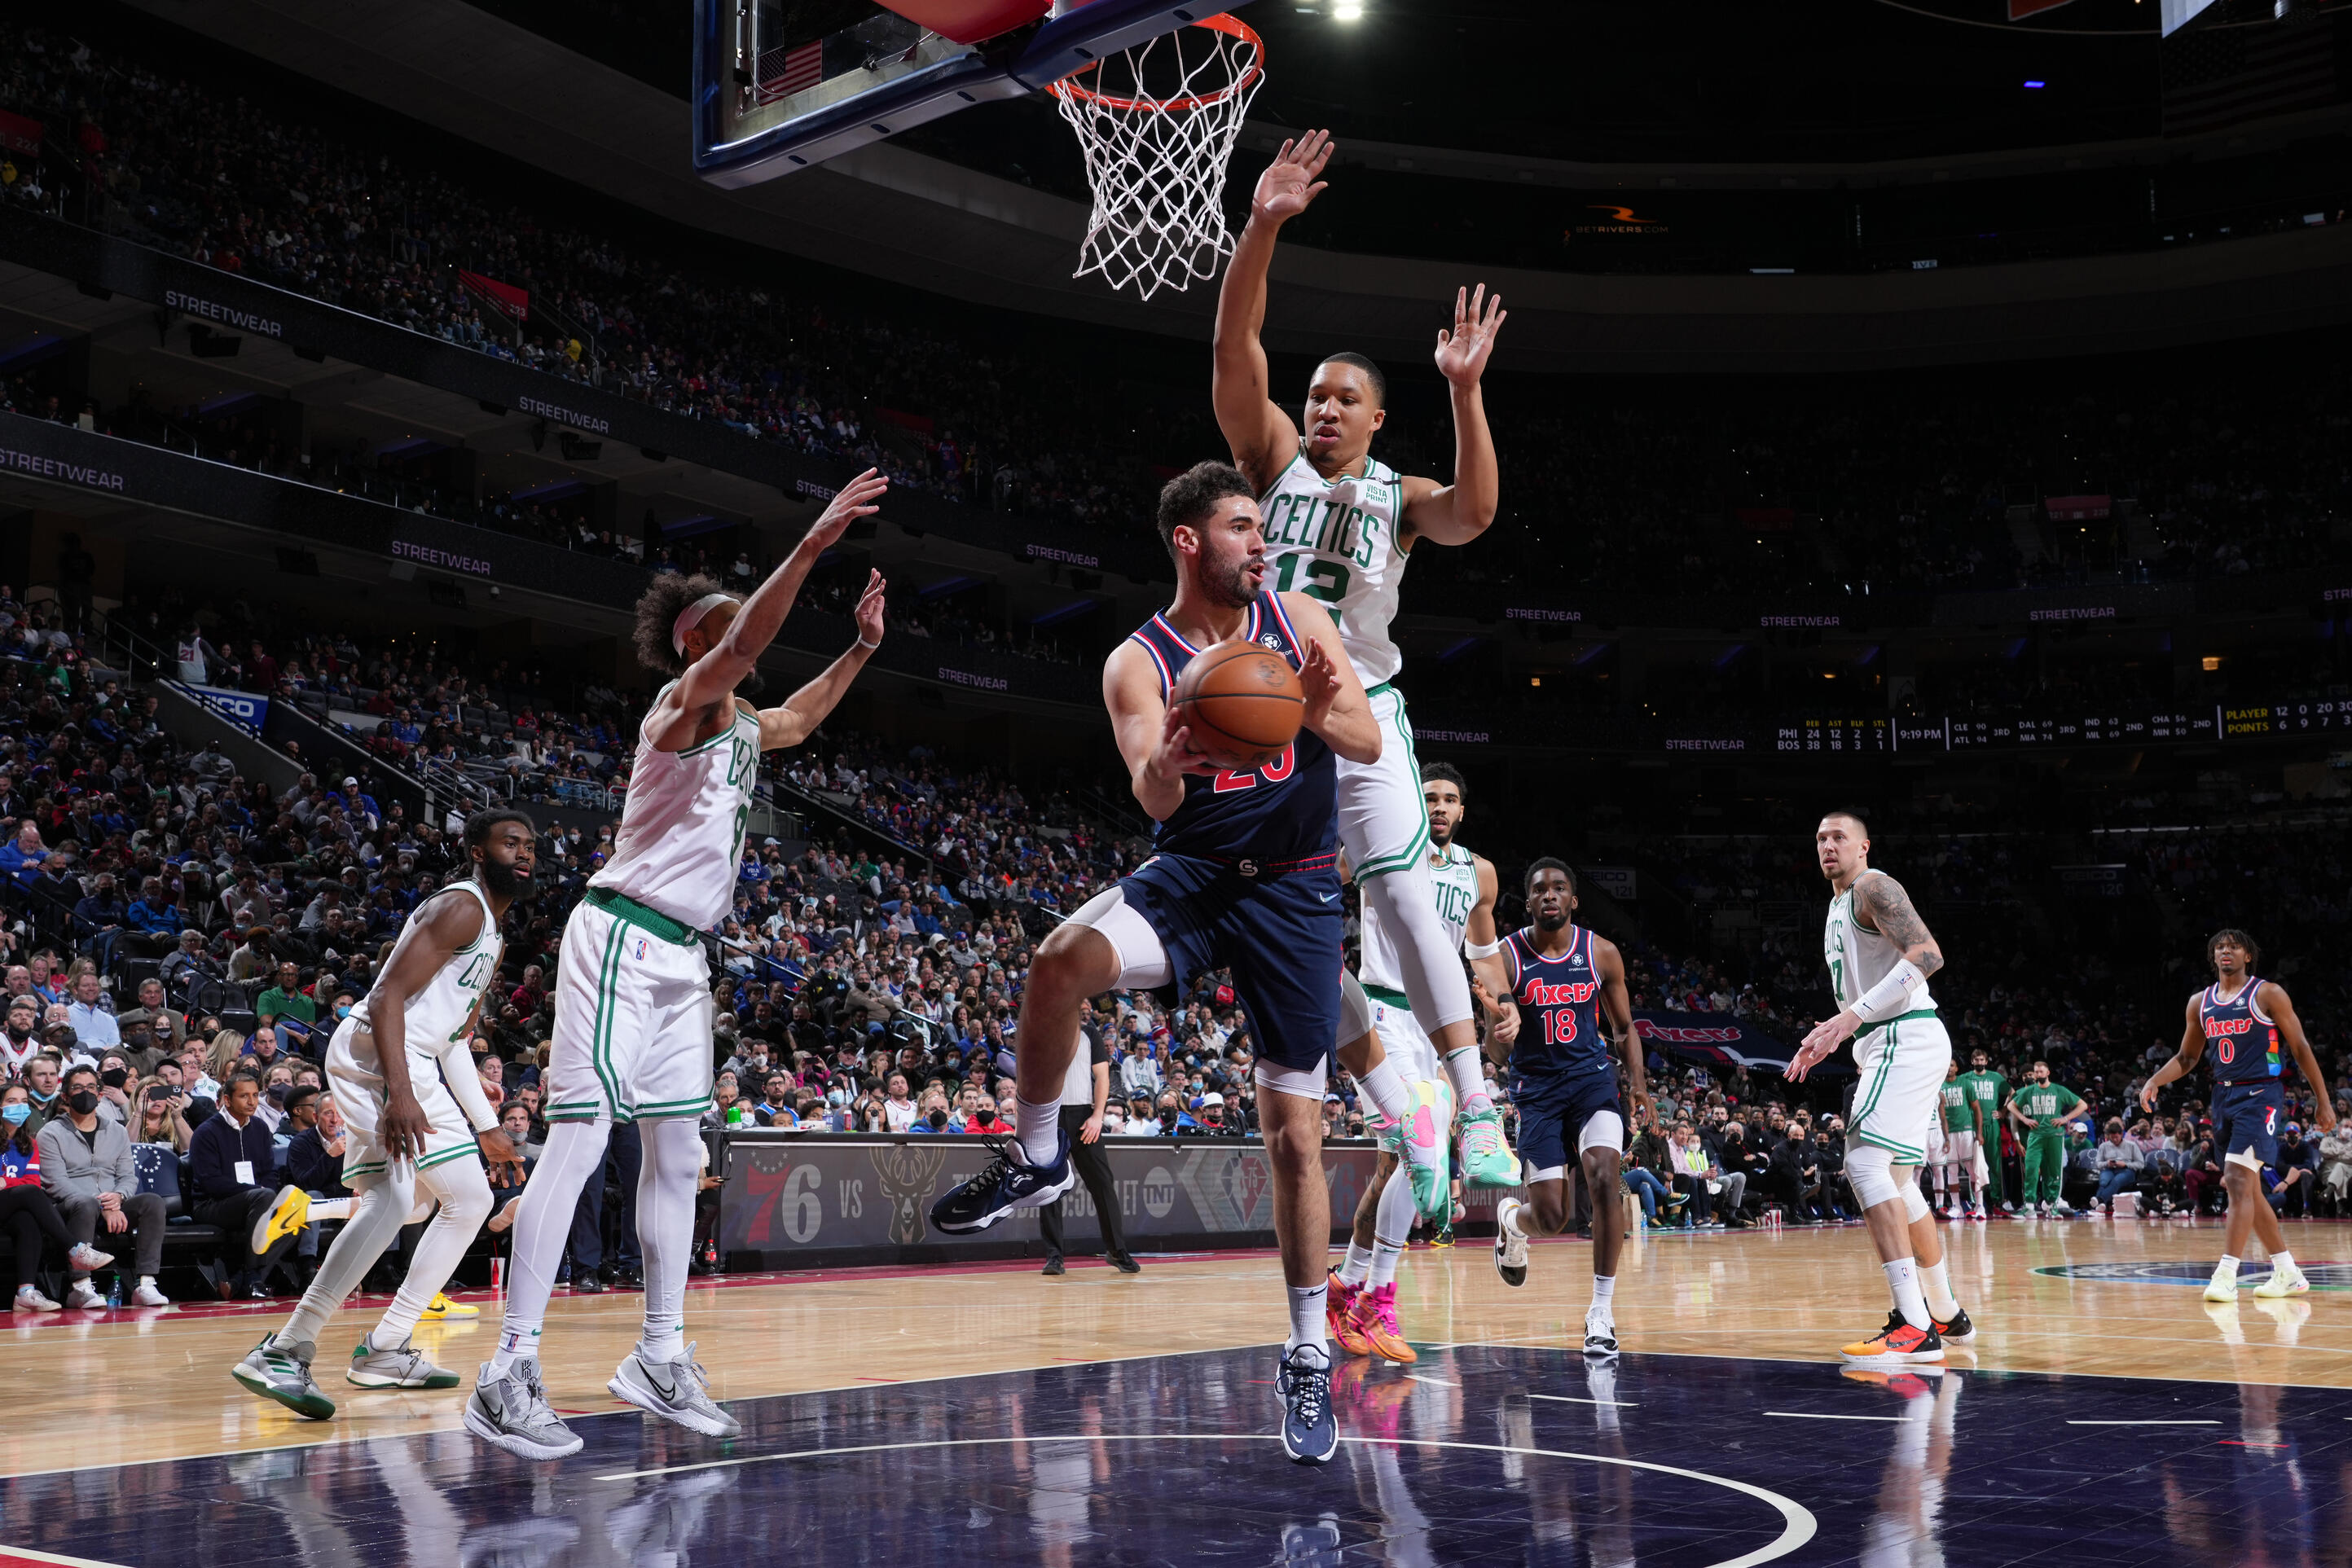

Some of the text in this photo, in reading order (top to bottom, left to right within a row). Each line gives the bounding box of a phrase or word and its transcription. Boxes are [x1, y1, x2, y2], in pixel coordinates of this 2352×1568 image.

[1576, 226, 1668, 234] BETRIVERS.COM
[165, 290, 281, 337] STREETWEAR
[520, 396, 609, 433] STREETWEAR
[0, 447, 123, 491] STREETWEAR
[1366, 484, 1387, 498] VISTA
[1366, 492, 1388, 504] PRINT
[1264, 494, 1380, 569] CELTICS
[392, 540, 490, 576] STREETWEAR
[1027, 544, 1098, 568] STREETWEAR
[1506, 608, 1582, 621] STREETWEAR
[2029, 607, 2116, 621] STREETWEAR
[1760, 616, 1840, 626] STREETWEAR
[178, 649, 195, 661] 21
[939, 667, 1008, 691] STREETWEAR
[2226, 708, 2269, 720] PLAYER
[2275, 705, 2288, 716] 12
[2298, 704, 2308, 714] 0
[2316, 702, 2334, 714] 20
[2019, 719, 2053, 729] DAL 69
[2085, 718, 2118, 727] IND 63
[2152, 715, 2170, 724] CHA
[2193, 719, 2212, 729] 2ND
[2227, 714, 2352, 733] POINTS 6 9 7 3
[1954, 723, 1987, 731] CLE 90
[1994, 727, 2011, 737] 3RD
[2060, 725, 2077, 734] 3RD
[2126, 723, 2144, 731] 2ND
[2152, 727, 2187, 737] MIN 50
[1413, 729, 1490, 743] STREETWEAR
[1778, 728, 1883, 739] PHI 24 12 2 2
[1900, 729, 1941, 740] 9:19 PM
[2020, 733, 2053, 742] MIA 74
[2086, 730, 2120, 739] MIL 69
[1666, 739, 1745, 750] STREETWEAR
[1777, 740, 1884, 750] BOS 38 18 3 1
[1954, 736, 1970, 744] ATL
[1616, 885, 1633, 897] 121
[1431, 881, 1472, 927] TICS
[1519, 977, 1595, 1006] Sixers
[1541, 1008, 1578, 1045] 18
[2205, 1016, 2253, 1039] Sixers
[2218, 1038, 2235, 1064] 0
[1248, 1166, 1258, 1188] 75
[1123, 1180, 1138, 1215] ET
[747, 1163, 863, 1245] 76 VS
